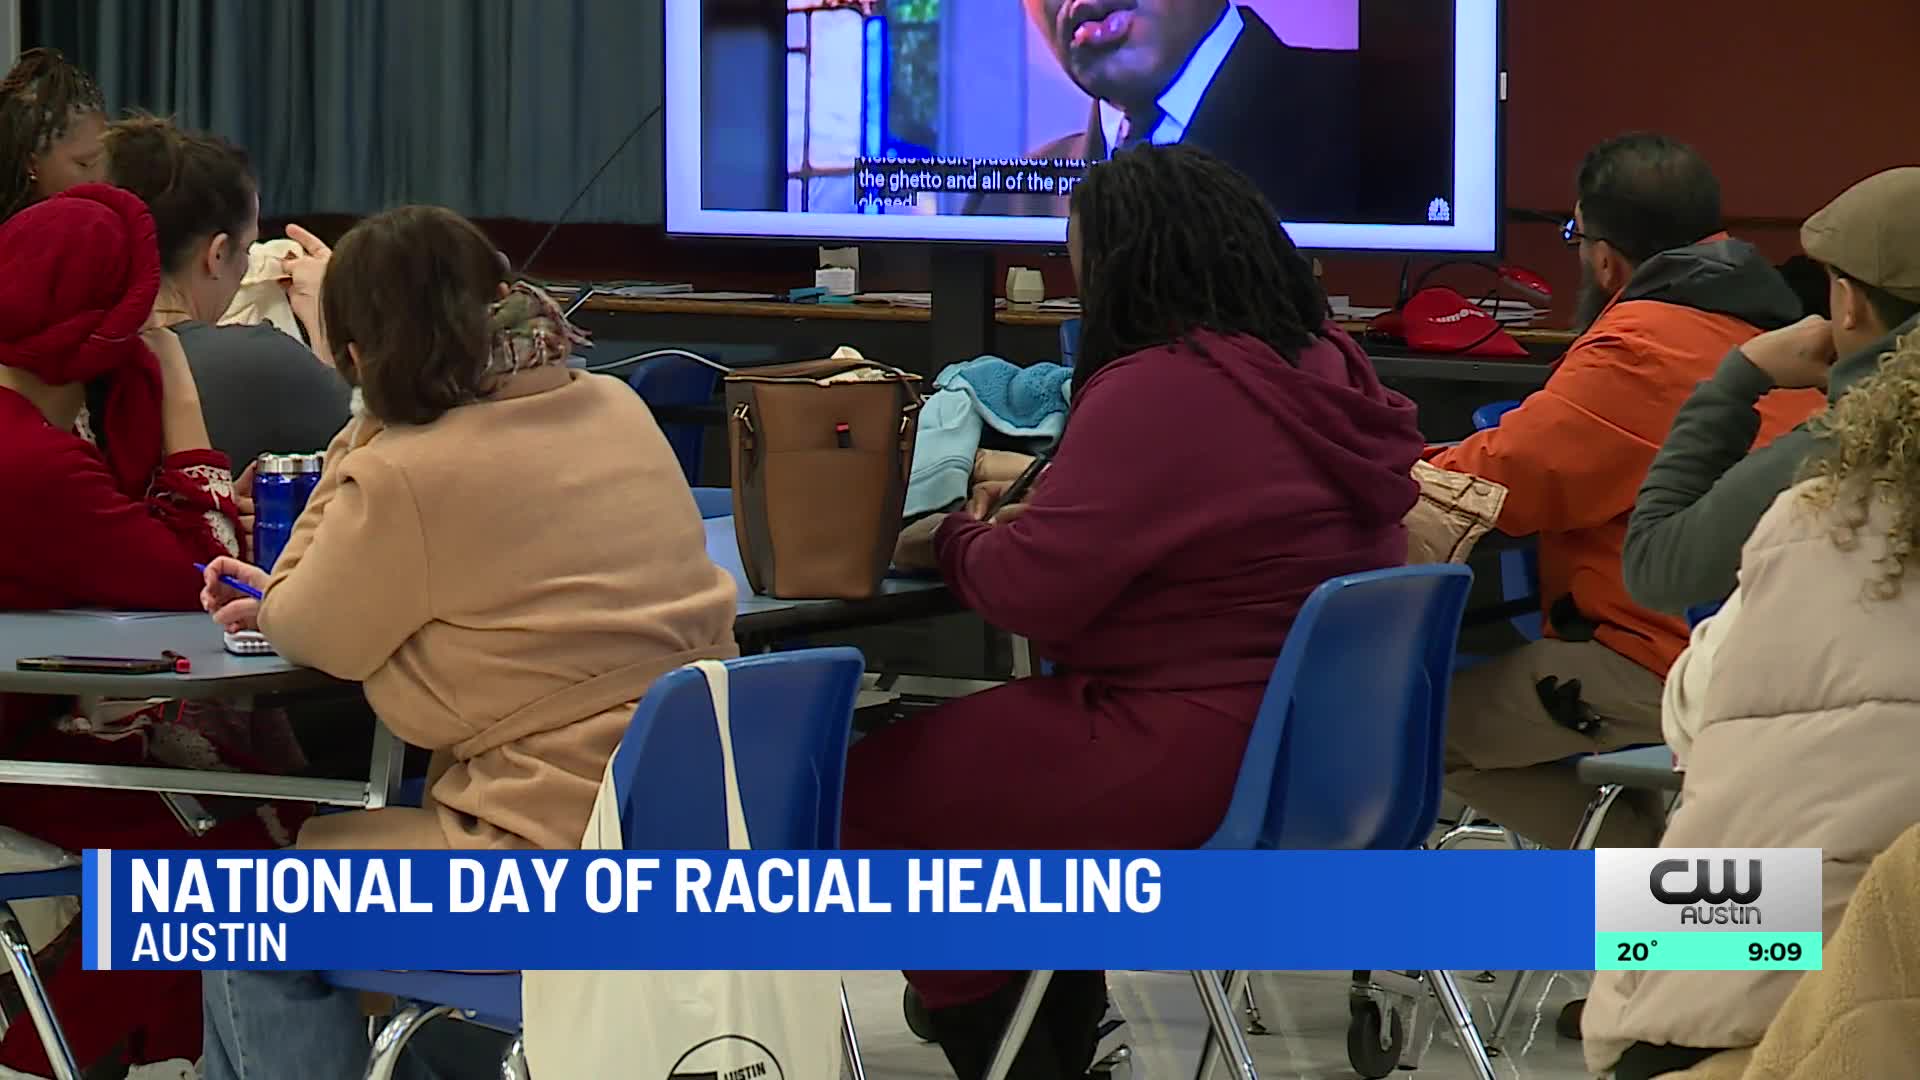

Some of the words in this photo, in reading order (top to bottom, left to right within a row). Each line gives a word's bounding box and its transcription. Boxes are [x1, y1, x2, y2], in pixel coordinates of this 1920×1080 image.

[859, 168, 885, 188] the
[889, 168, 942, 192] ghetto
[946, 170, 977, 190] and
[982, 170, 1000, 190] all
[1005, 171, 1024, 190] of
[1027, 171, 1054, 191] the
